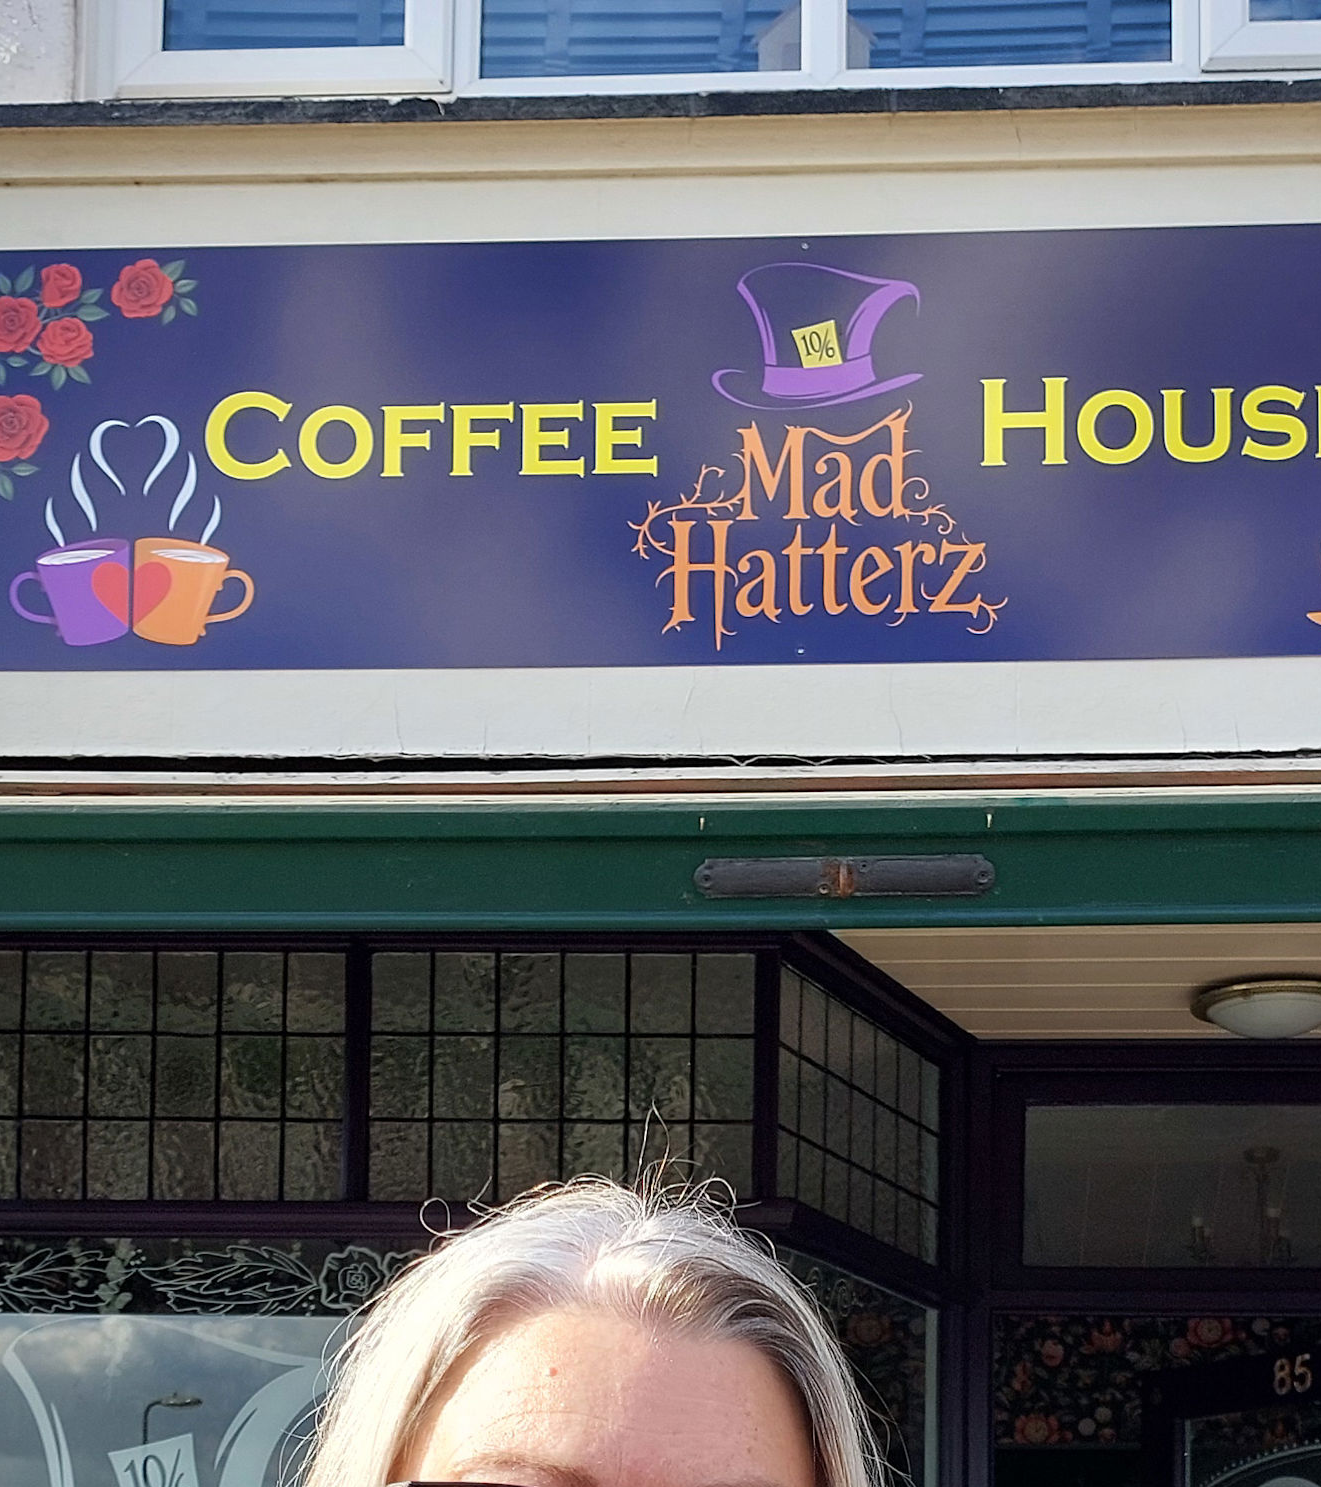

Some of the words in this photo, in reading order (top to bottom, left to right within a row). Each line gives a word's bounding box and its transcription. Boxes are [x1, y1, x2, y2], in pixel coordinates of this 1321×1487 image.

[801, 328, 836, 362] 10/6
[205, 391, 659, 481] COFFEE
[693, 400, 948, 526] Mad
[655, 519, 1009, 651] Hatterz
[1273, 1353, 1313, 1395] 85
